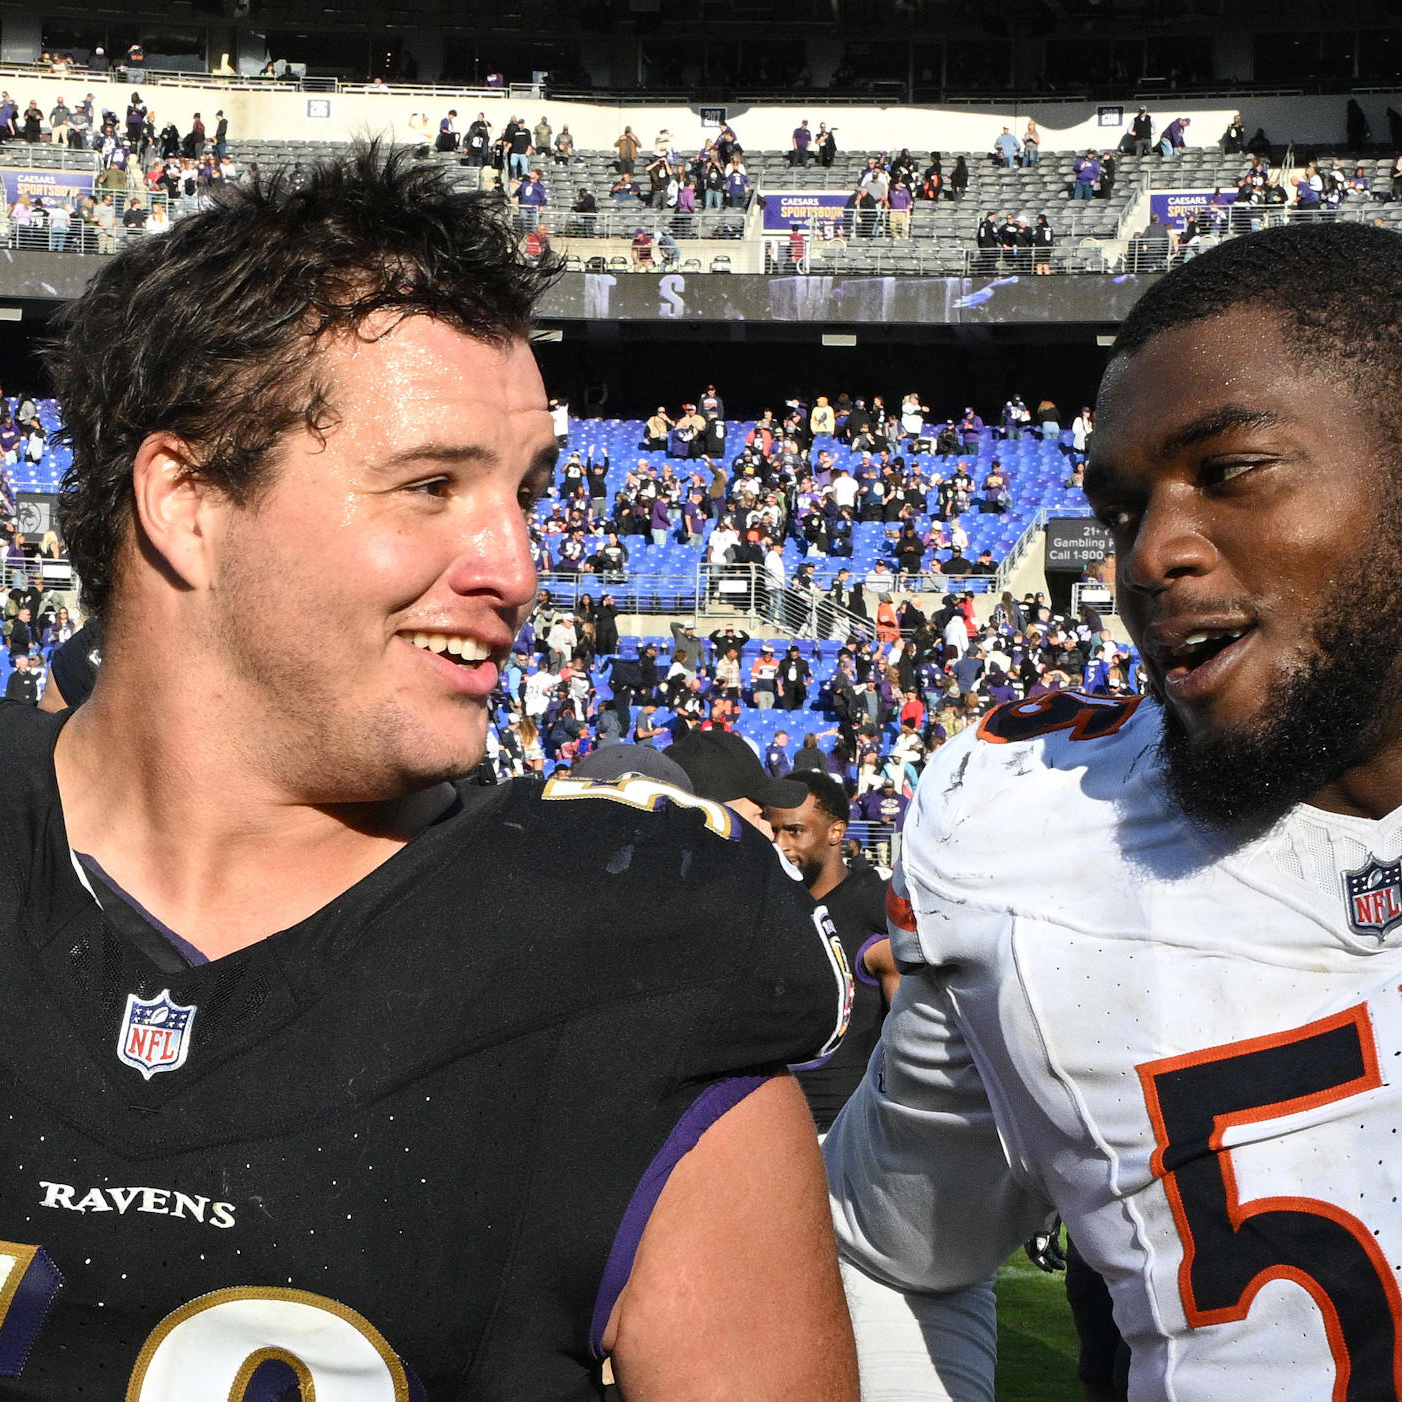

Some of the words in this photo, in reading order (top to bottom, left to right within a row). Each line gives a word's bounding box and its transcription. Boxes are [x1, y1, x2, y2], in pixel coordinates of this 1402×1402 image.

[17, 175, 56, 184] CAESARS
[781, 198, 819, 206] CAESARS
[1168, 197, 1207, 206] CAESARS
[1054, 538, 1105, 550] Gambling
[1049, 551, 1070, 561] Call
[1354, 888, 1401, 925] NFL
[128, 1026, 176, 1063] NFL
[39, 1180, 237, 1230] RAVENS
